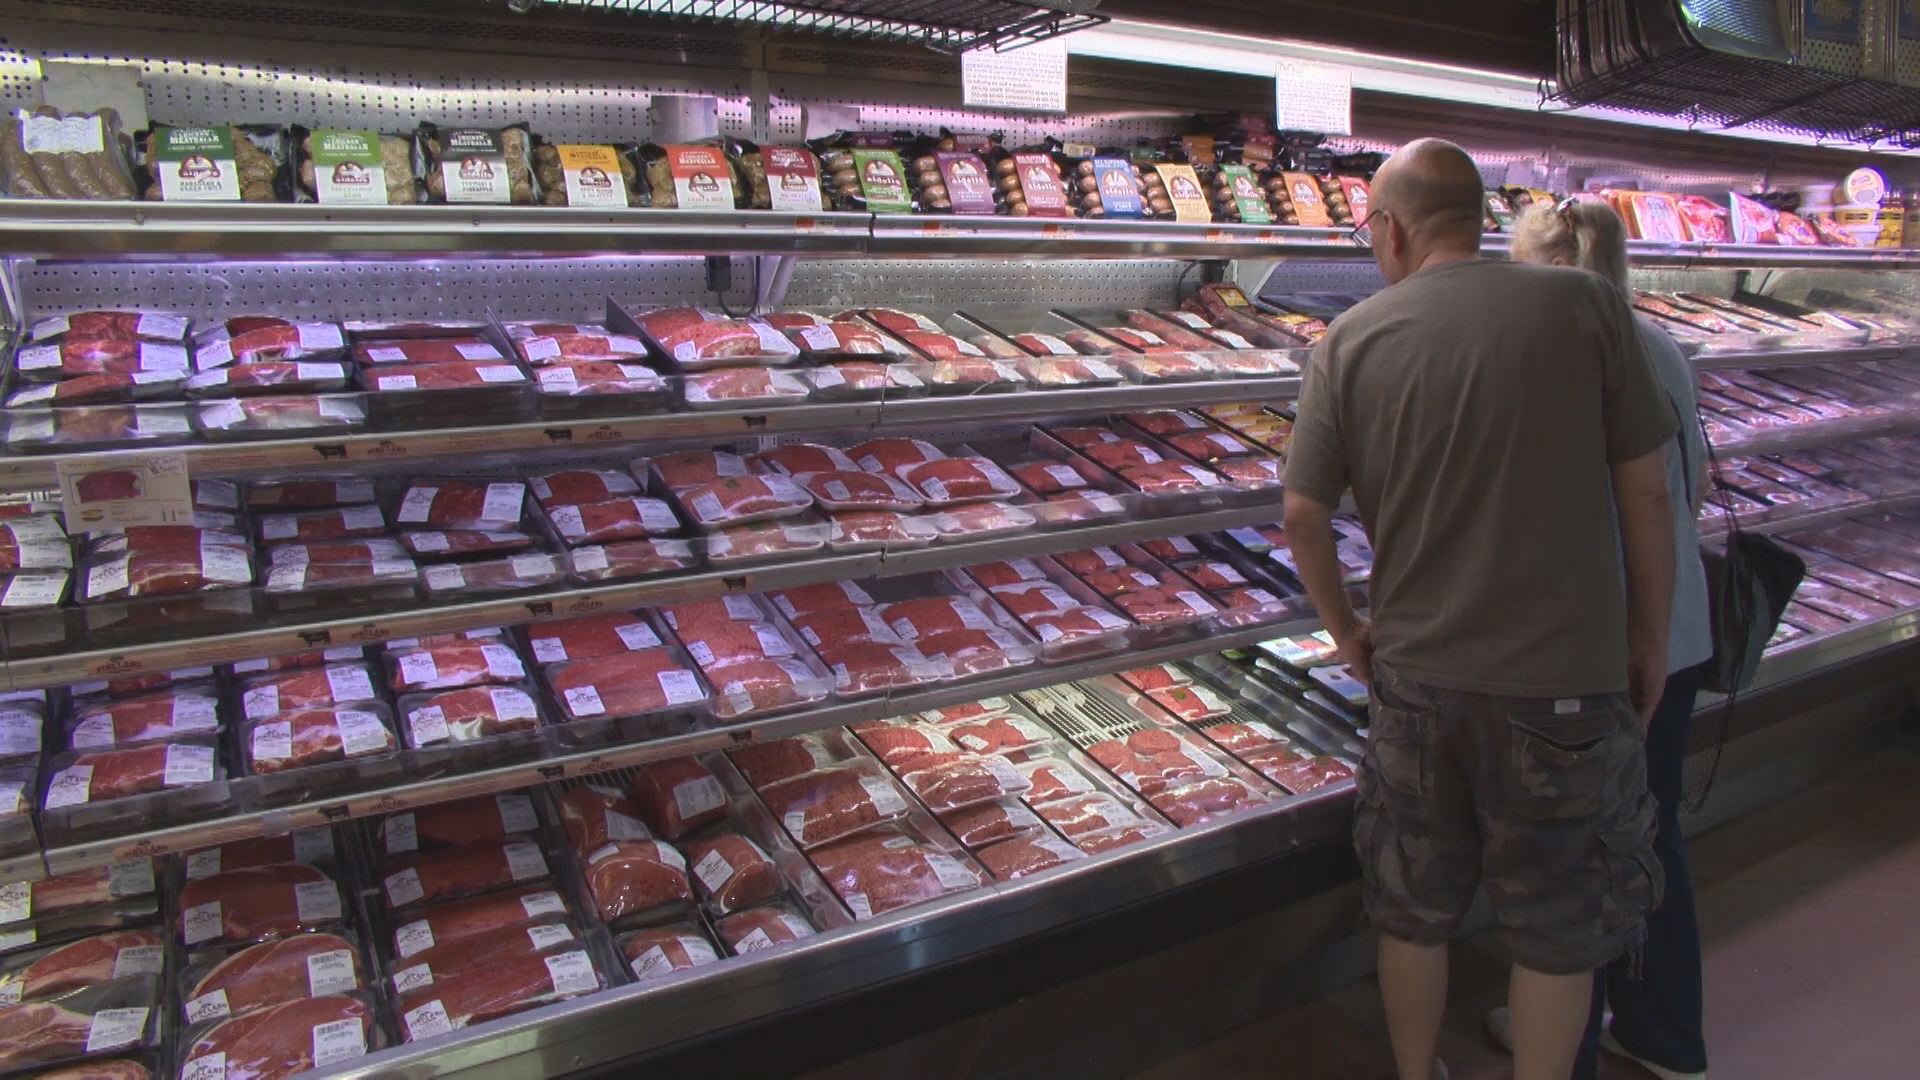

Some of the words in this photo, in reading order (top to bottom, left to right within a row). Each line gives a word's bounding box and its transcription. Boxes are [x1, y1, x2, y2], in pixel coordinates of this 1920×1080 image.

[866, 176, 901, 185] aidells
[1027, 182, 1058, 190] aidells
[161, 509, 177, 522] 11
